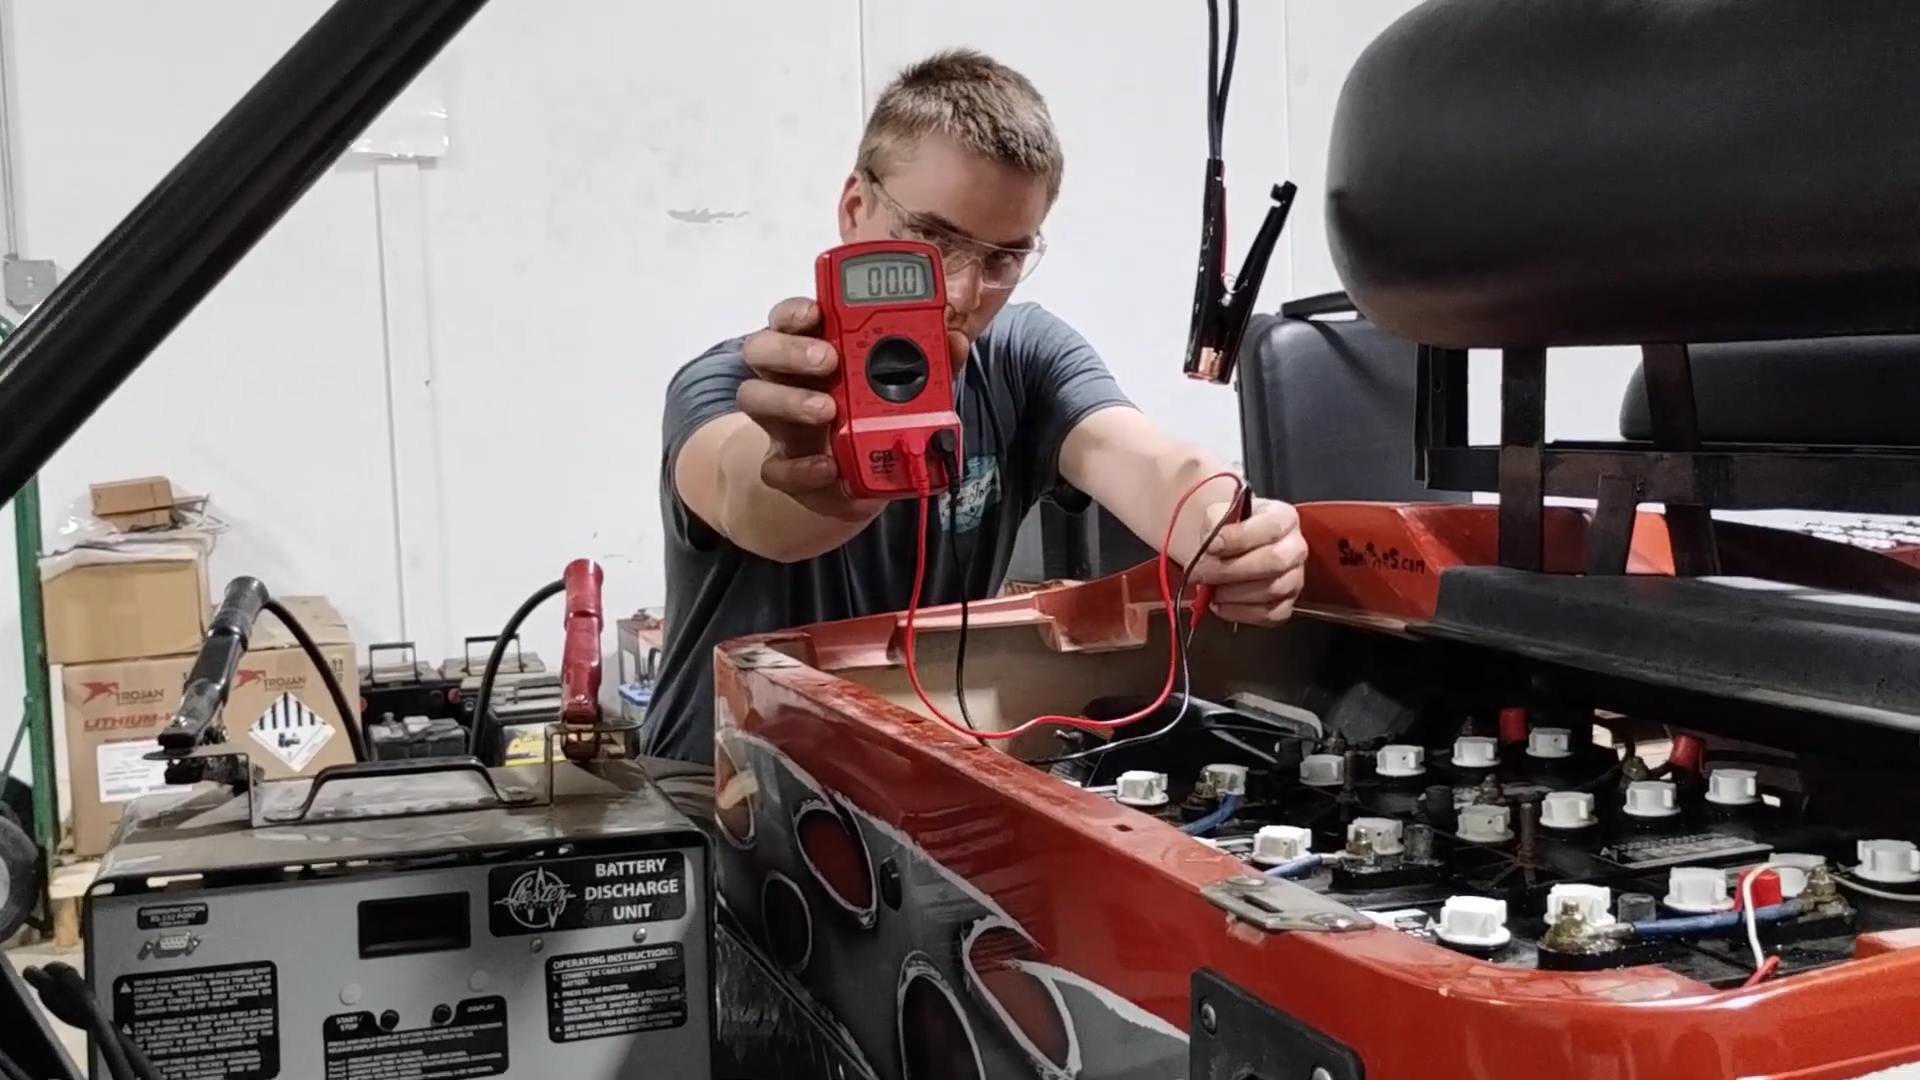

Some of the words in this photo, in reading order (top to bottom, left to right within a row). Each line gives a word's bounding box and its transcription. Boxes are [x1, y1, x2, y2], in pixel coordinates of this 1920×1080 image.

[264, 676, 306, 689] TROJAN
[115, 688, 165, 703] TROJAN
[595, 858, 667, 878] BATTERY
[584, 879, 679, 901] DISCHARGE
[612, 903, 653, 920] UNIT
